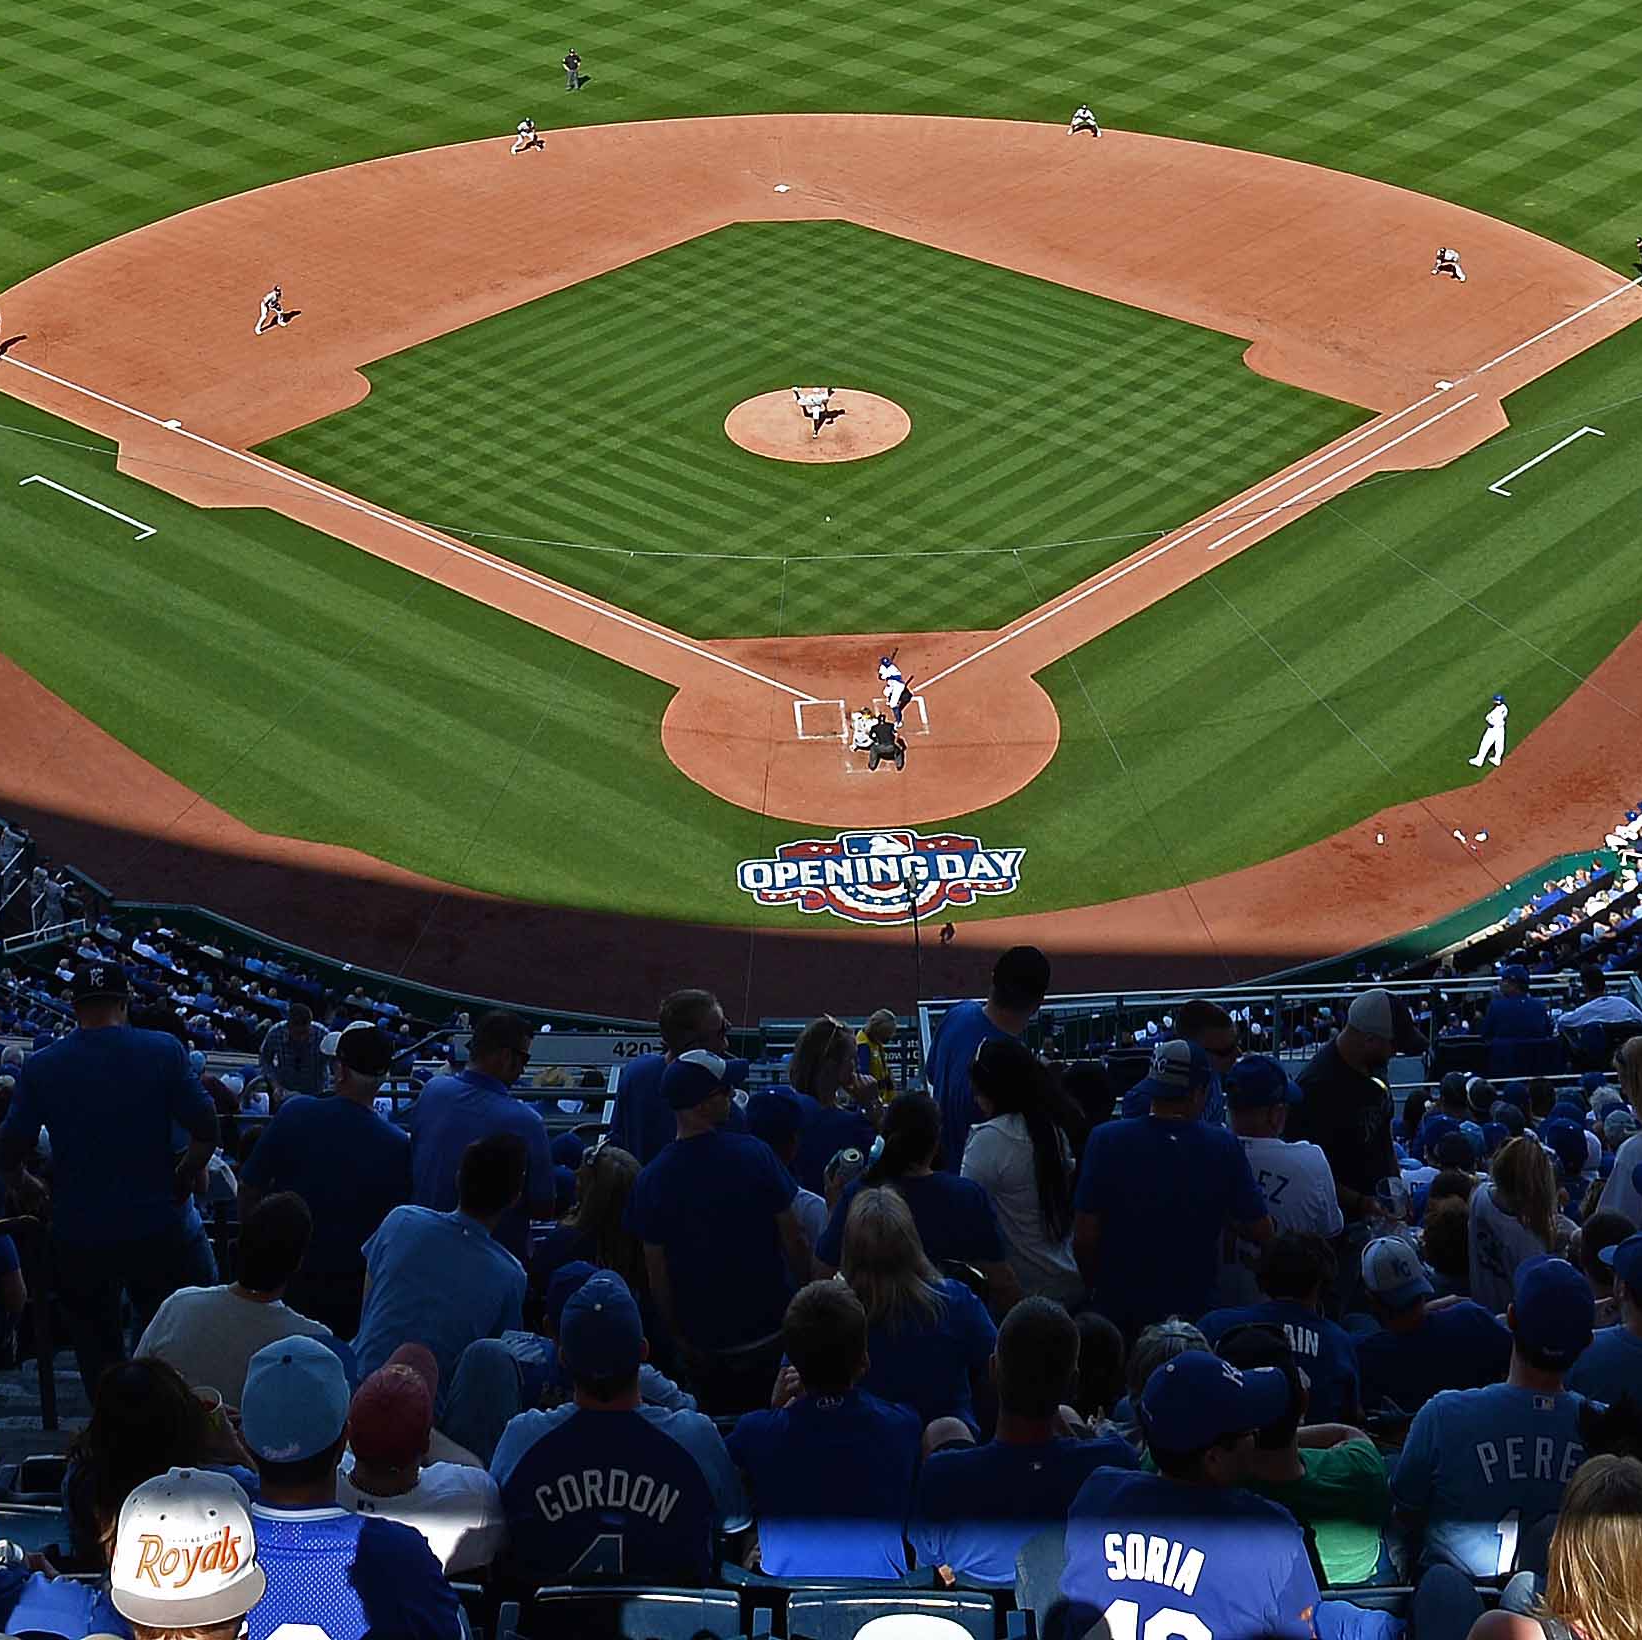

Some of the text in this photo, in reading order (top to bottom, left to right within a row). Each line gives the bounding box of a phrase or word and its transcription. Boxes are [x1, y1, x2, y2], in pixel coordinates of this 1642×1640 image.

[742, 851, 1018, 890] OPENING DAY
[612, 1041, 652, 1058] 420
[535, 1467, 682, 1525] GORDON
[134, 1525, 242, 1589] Royals
[1104, 1532, 1206, 1598] SORIA
